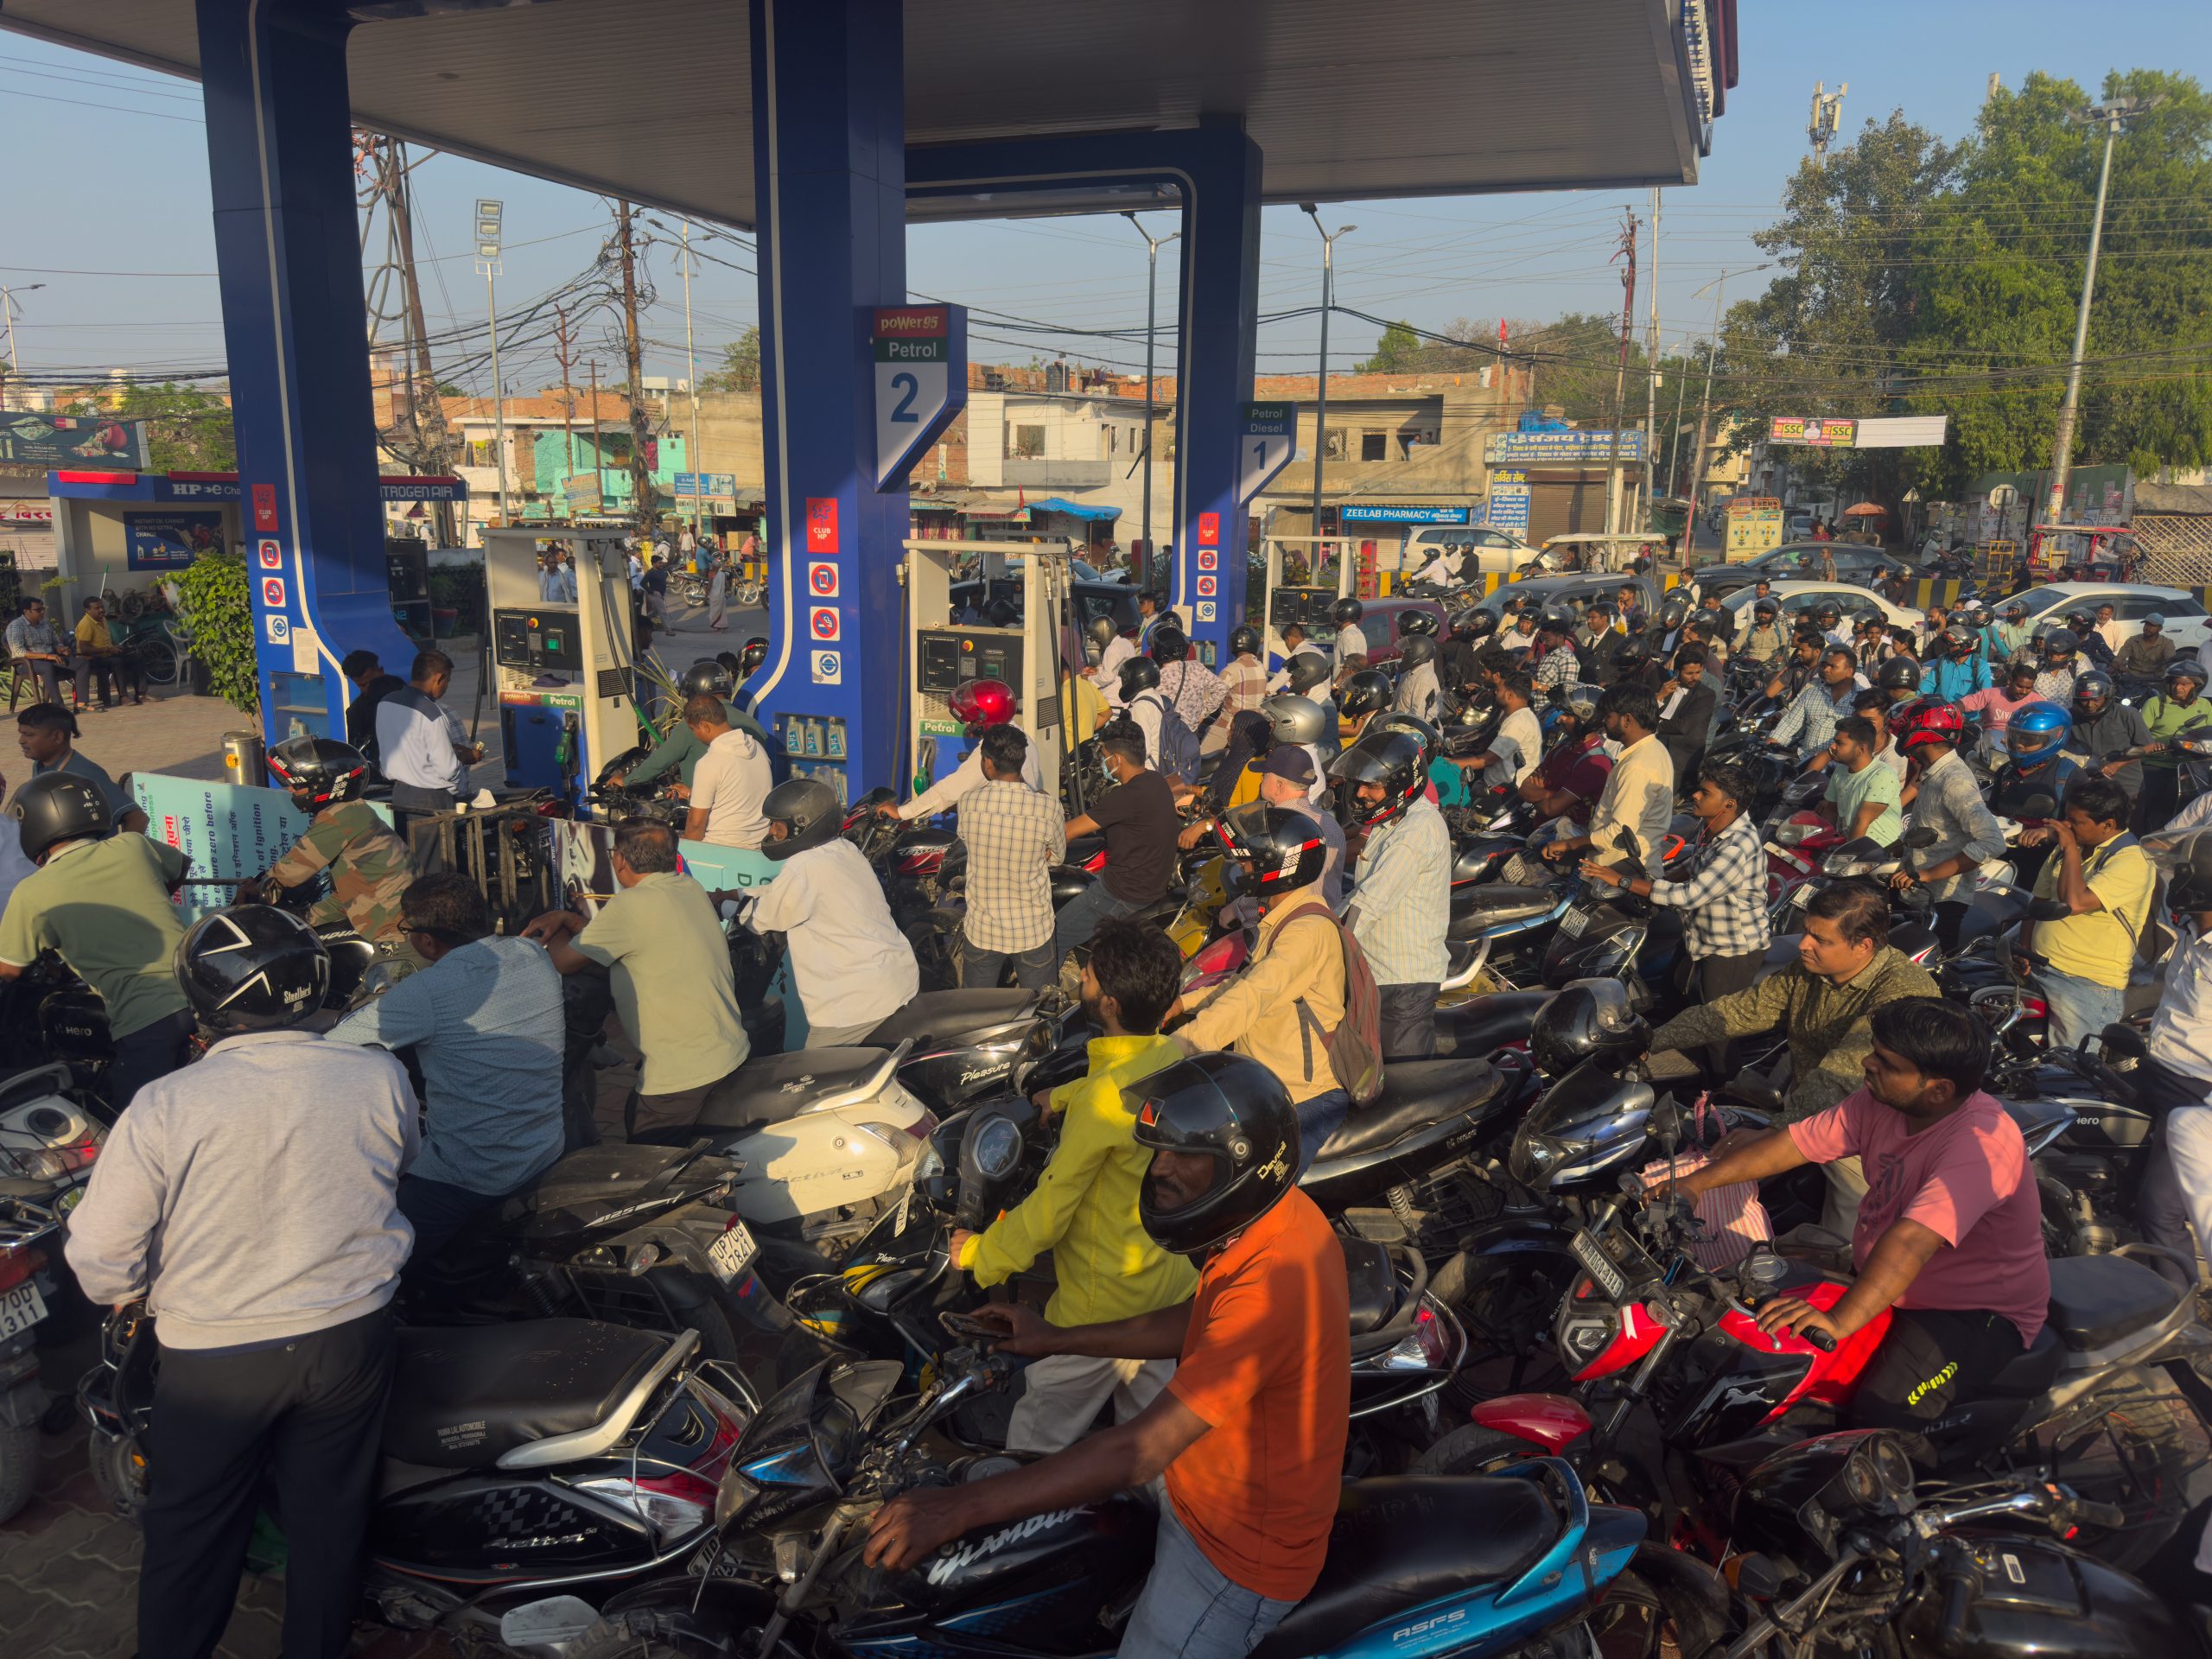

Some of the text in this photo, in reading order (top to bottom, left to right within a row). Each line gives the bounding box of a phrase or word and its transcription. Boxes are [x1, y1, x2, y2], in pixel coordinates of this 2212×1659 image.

[889, 342, 937, 357] Petrol
[890, 372, 918, 423] 2
[1251, 409, 1282, 418] Petrol
[1250, 423, 1282, 432] Diesel
[1783, 425, 1802, 434] SSC
[1832, 427, 1851, 435] SSC
[1253, 441, 1266, 469] 1
[1493, 470, 1512, 483] सर्विस
[172, 484, 202, 495] HP
[380, 486, 454, 498] ITROGEN AIR
[1346, 509, 1382, 518] ZEELAB
[1383, 510, 1431, 518] PHARMACY
[550, 696, 575, 706] Petrol
[925, 722, 956, 734] Petrol
[204, 791, 214, 828] before
[148, 794, 159, 841] appiness
[253, 803, 265, 861] of Ignition
[207, 830, 218, 855] zero
[284, 982, 311, 1002] Steelbird
[66, 1026, 93, 1037] Hero
[960, 1062, 1011, 1085] Pleasure
[599, 1206, 638, 1223] 125
[482, 1527, 598, 1549] Activa 5G
[1393, 1610, 1465, 1641] ASFS
